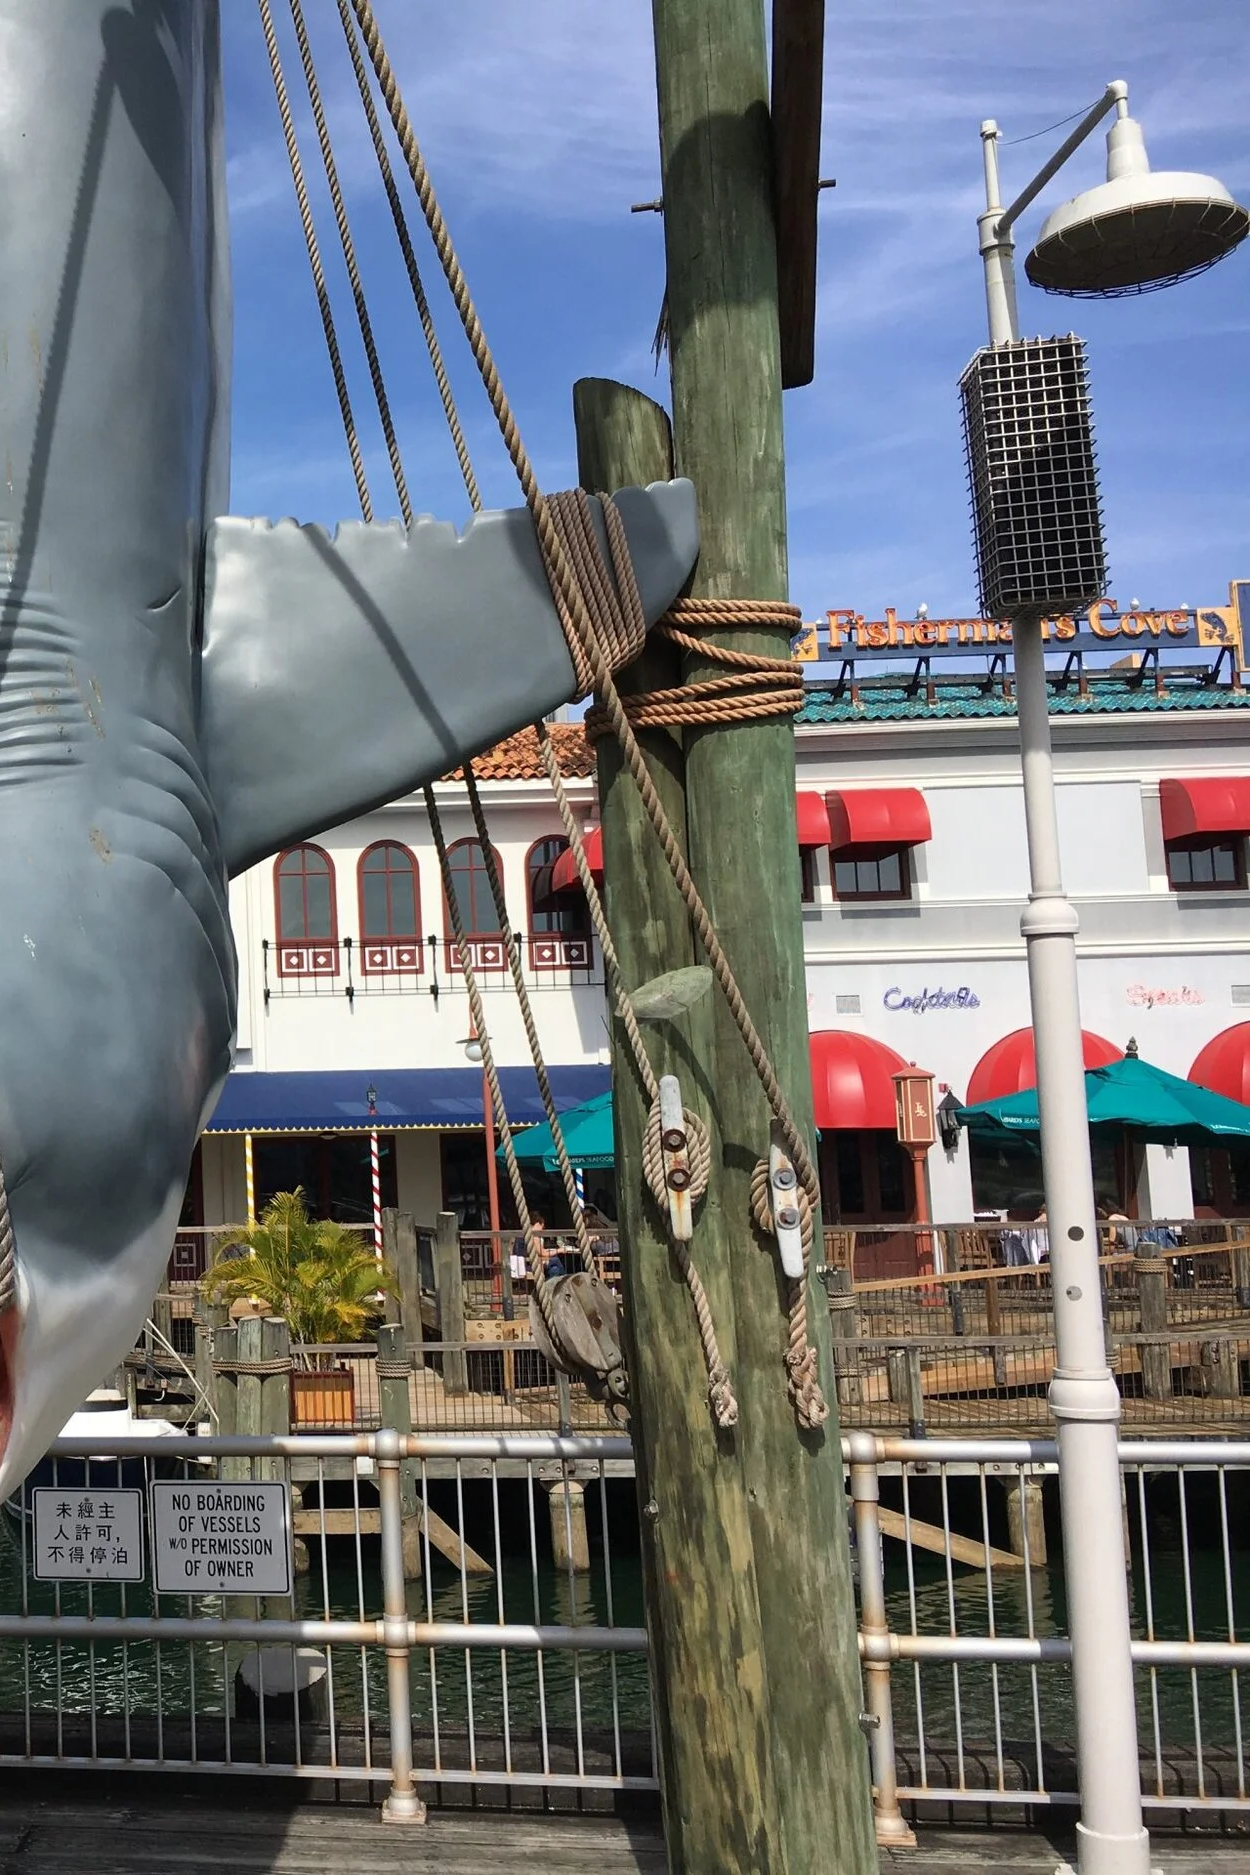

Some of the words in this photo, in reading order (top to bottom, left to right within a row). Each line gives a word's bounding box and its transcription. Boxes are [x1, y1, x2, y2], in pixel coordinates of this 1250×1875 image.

[1087, 597, 1190, 640] Cove
[56, 1502, 116, 1519] 未經主
[172, 1494, 191, 1511] NO
[197, 1494, 265, 1511] BOARDING
[178, 1516, 196, 1533] OF
[201, 1516, 261, 1533] VESSELS
[47, 1546, 128, 1564] 不得停泊
[169, 1538, 188, 1549] W/O
[191, 1538, 273, 1555] PERMISSION
[184, 1560, 202, 1577] OF
[207, 1560, 254, 1577] OWNER
